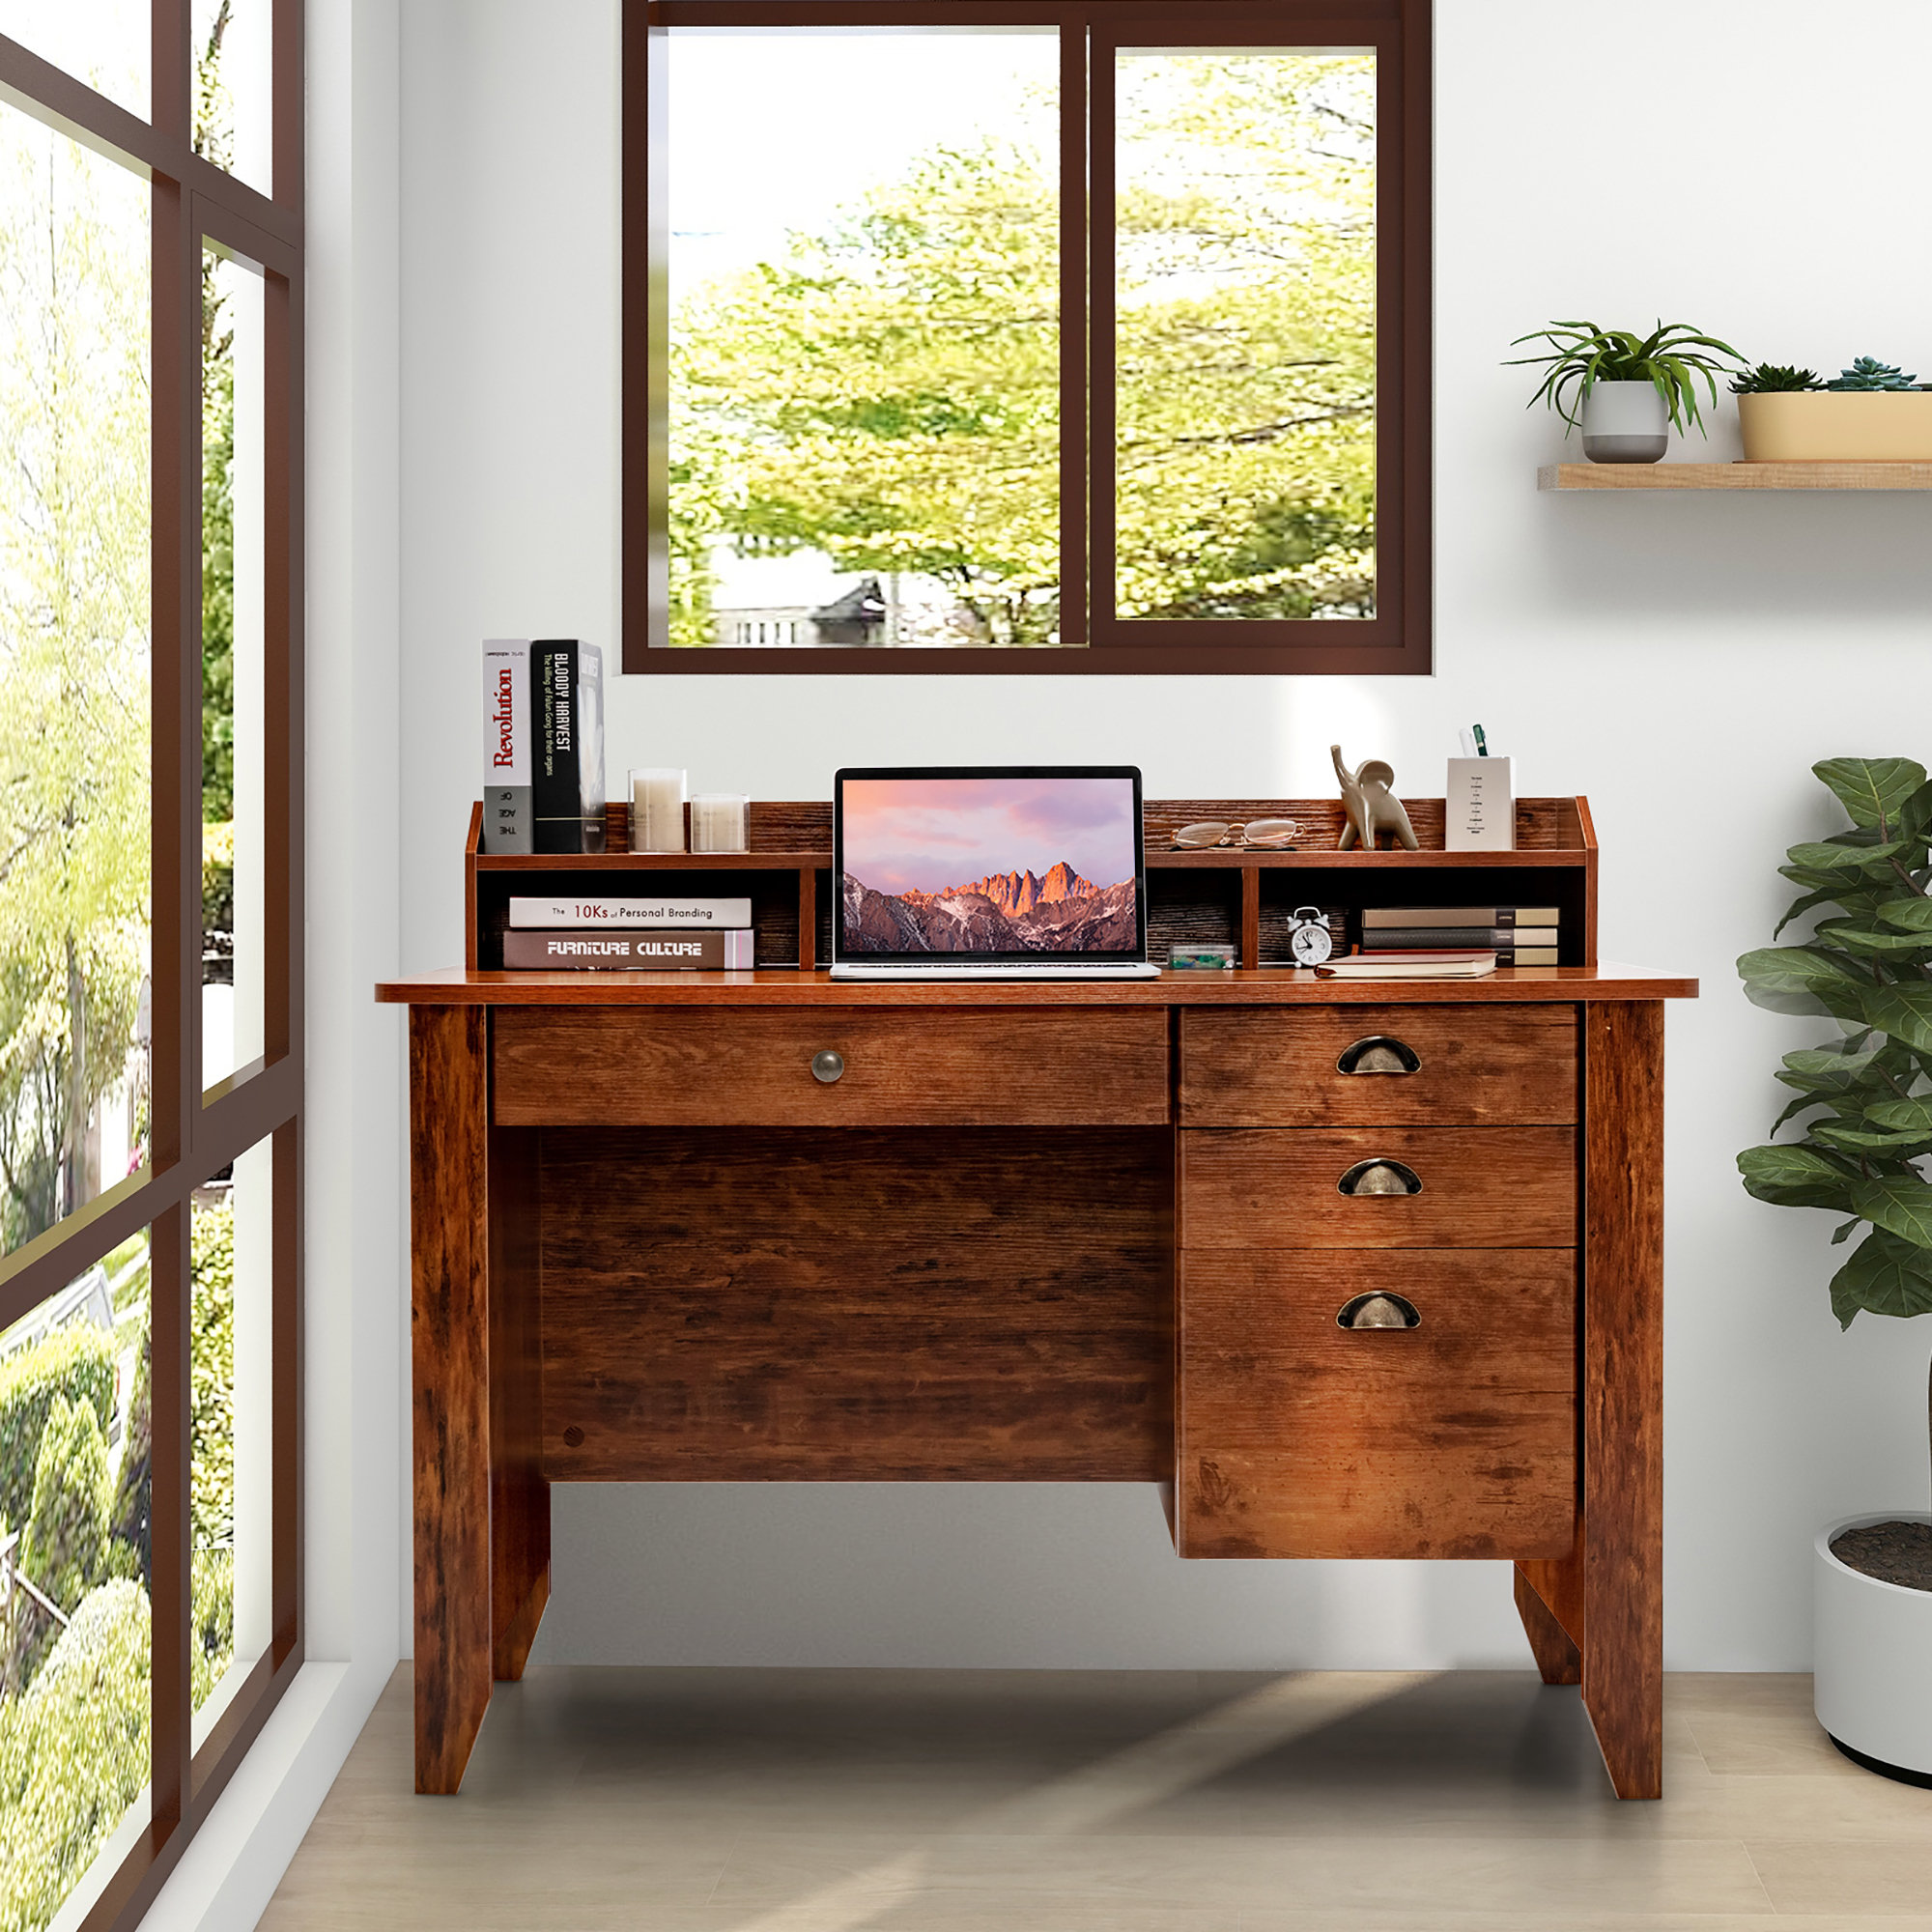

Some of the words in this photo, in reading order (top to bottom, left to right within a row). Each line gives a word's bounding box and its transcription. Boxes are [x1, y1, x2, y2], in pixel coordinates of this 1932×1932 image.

[544, 654, 553, 666] The
[543, 667, 553, 685] killing
[554, 653, 570, 697] BLOODY
[545, 695, 554, 712] Falun
[493, 668, 513, 768] Revolution
[543, 712, 554, 728] Gong
[555, 700, 571, 752] HARVEST
[544, 729, 554, 739] for
[545, 739, 554, 754] their
[544, 755, 554, 776] organs
[499, 791, 512, 801] OF
[498, 809, 516, 817] AGE
[499, 826, 517, 835] THE
[575, 905, 609, 918] 10Ks
[619, 908, 664, 918] Personal
[668, 908, 713, 920] Branding
[548, 942, 630, 955] FURNITURE
[637, 942, 702, 956] CULTURE
